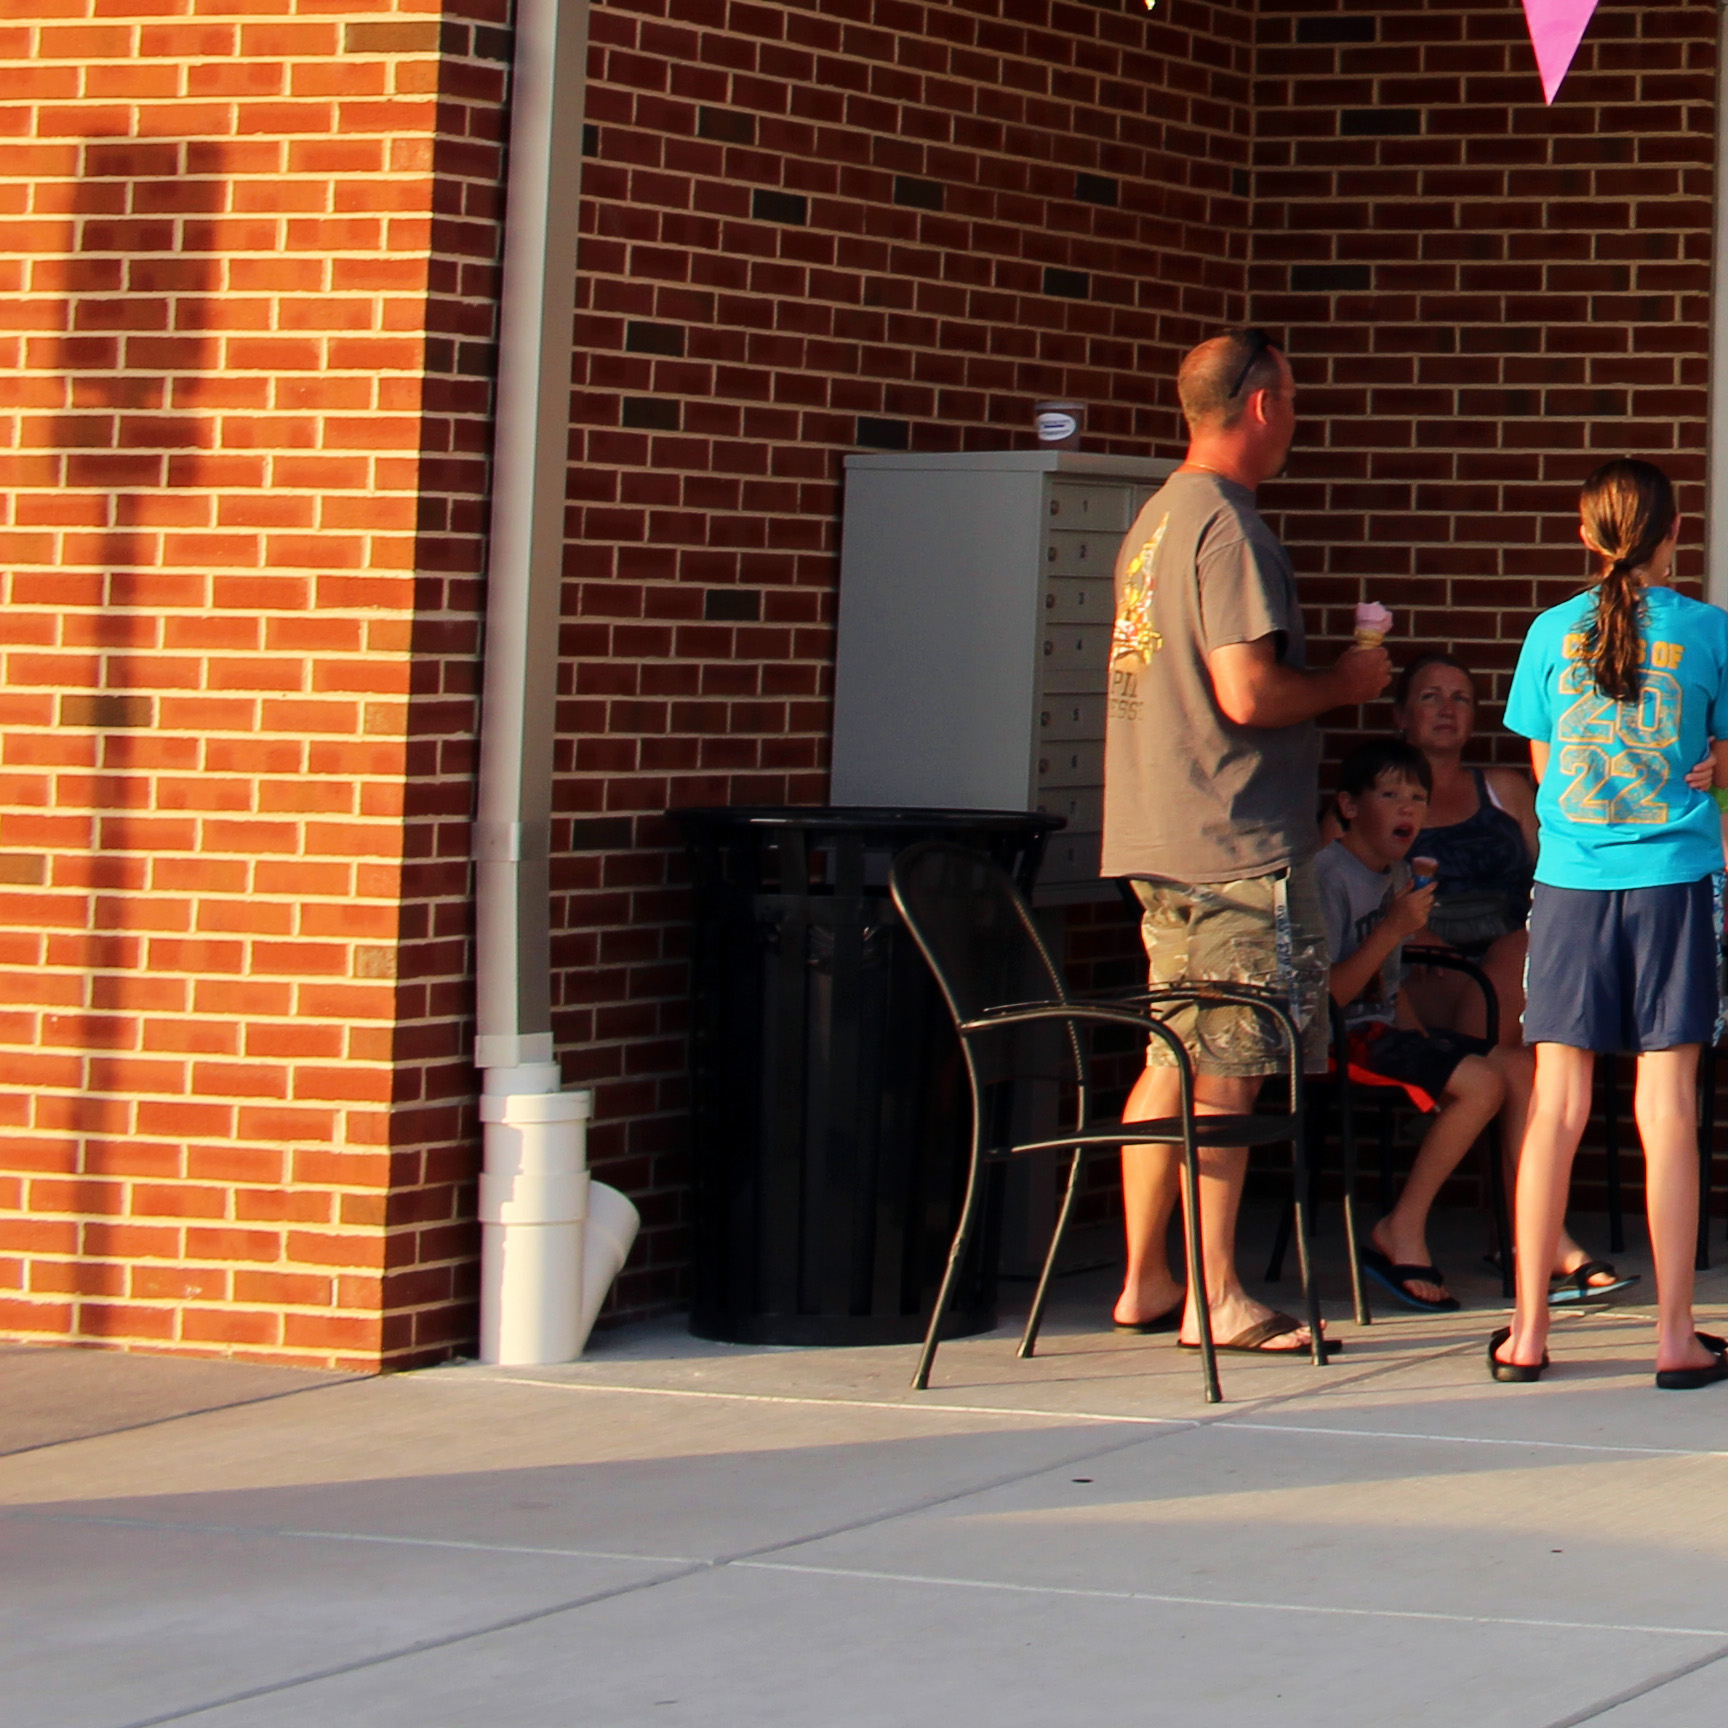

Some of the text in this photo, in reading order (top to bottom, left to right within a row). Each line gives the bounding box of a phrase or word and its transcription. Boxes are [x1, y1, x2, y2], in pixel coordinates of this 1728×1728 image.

[1651, 641, 1684, 670] OF
[1558, 662, 1683, 750] 20
[1558, 744, 1670, 825] 22
